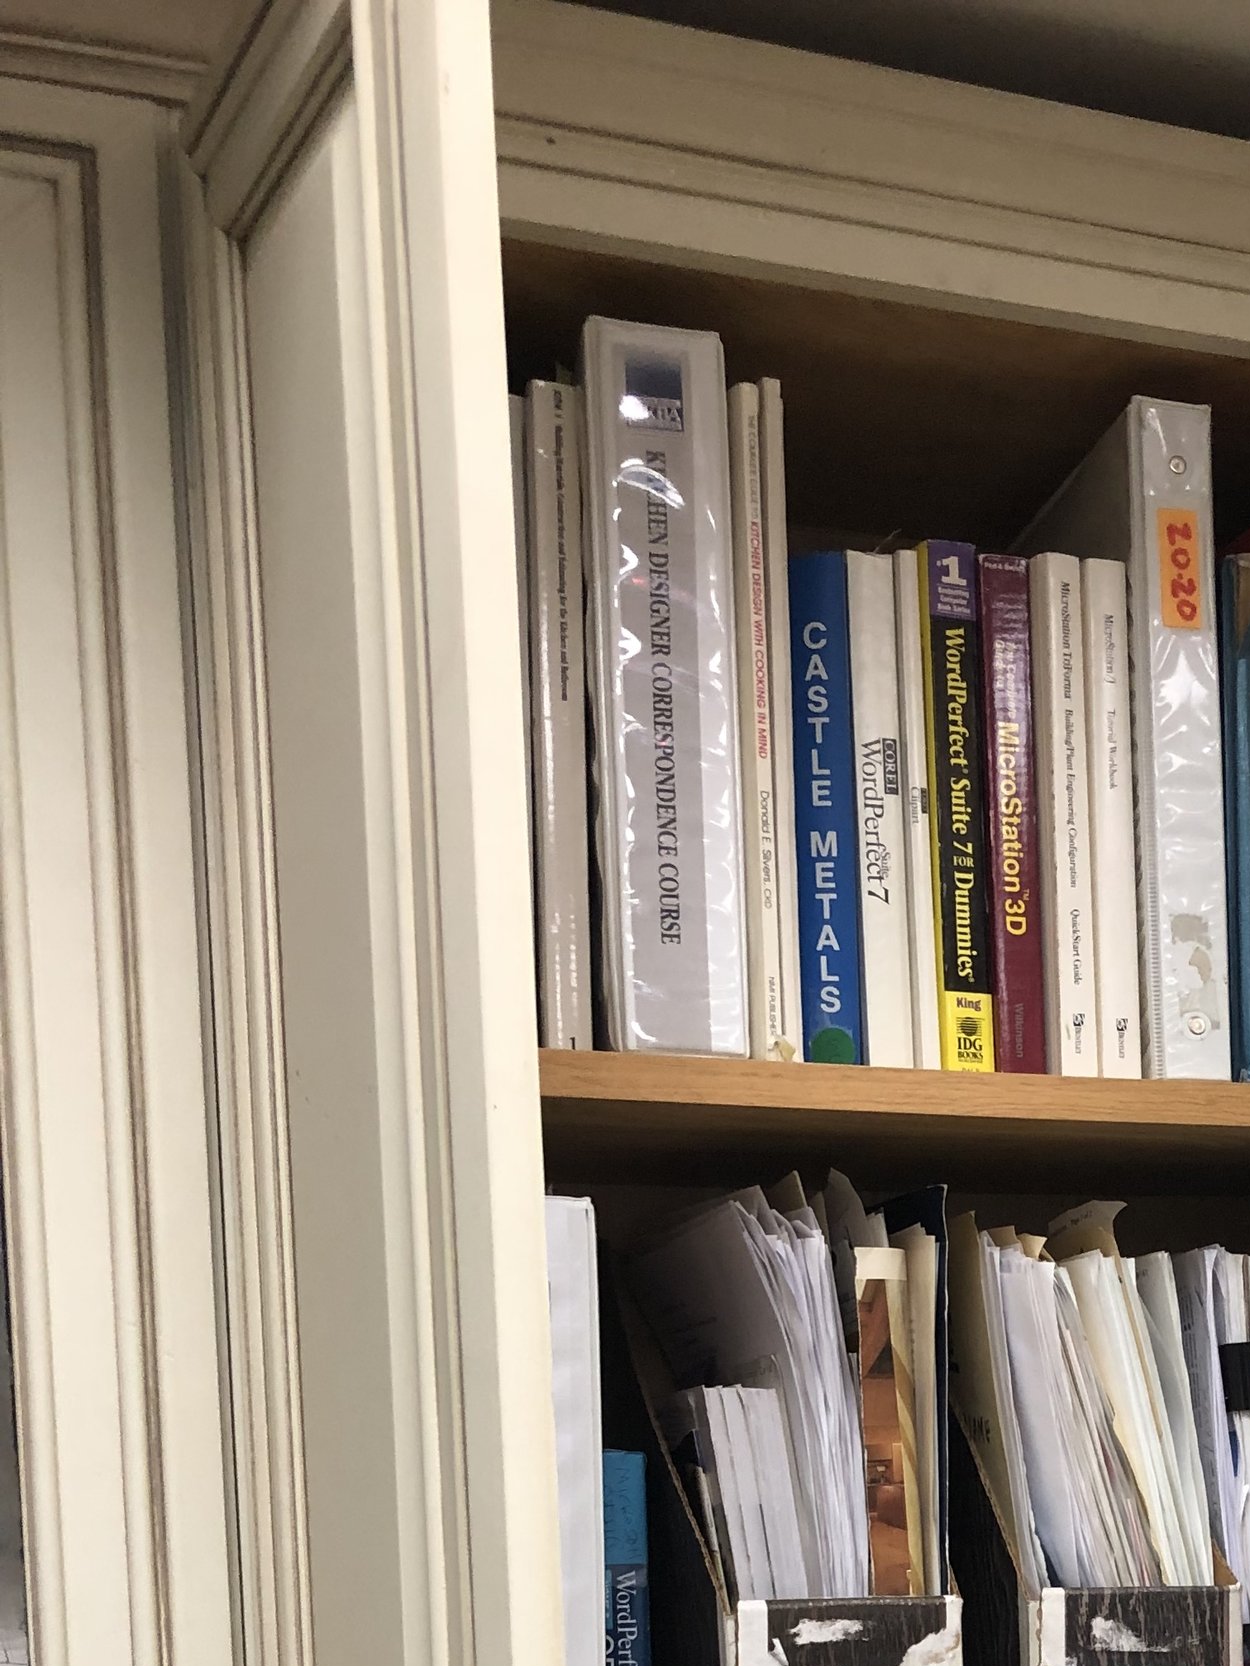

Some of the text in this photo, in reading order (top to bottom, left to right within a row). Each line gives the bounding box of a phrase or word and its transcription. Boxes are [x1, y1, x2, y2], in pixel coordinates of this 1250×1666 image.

[750, 521, 761, 569] KITCHEN
[649, 552, 671, 656] DESIGNER
[752, 573, 763, 616] DESIGN
[1060, 582, 1072, 650] MicroStation
[754, 620, 765, 646] WITH
[755, 650, 767, 708] COOKING
[1062, 652, 1073, 699] TriForma
[757, 712, 767, 724] IN
[1107, 709, 1117, 744] Tutorial
[652, 663, 678, 857] CORRESPONDENCE
[758, 728, 768, 759] MIND
[884, 739, 898, 795] COREL
[1107, 746, 1118, 790] Workbook
[760, 791, 771, 833] Donald
[803, 621, 841, 1013] CASTLE METALS
[861, 738, 889, 905] WordPerfect 7
[909, 786, 920, 824] Clipart
[950, 777, 973, 834] Suite
[1066, 773, 1077, 825] Engineering
[953, 840, 973, 854] 7
[997, 720, 1027, 936] MicroStation 3D
[880, 849, 891, 879] Suite
[953, 856, 975, 867] FOR
[1068, 828, 1078, 888] Configuration
[659, 863, 681, 945] COURSE
[1071, 909, 1081, 957] QuickStart
[1073, 959, 1082, 985] Guide
[956, 997, 982, 1012] King
[957, 1037, 983, 1051] IDG
[1014, 1003, 1024, 1058] Wilkinson
[957, 1051, 984, 1059] BOOKS
